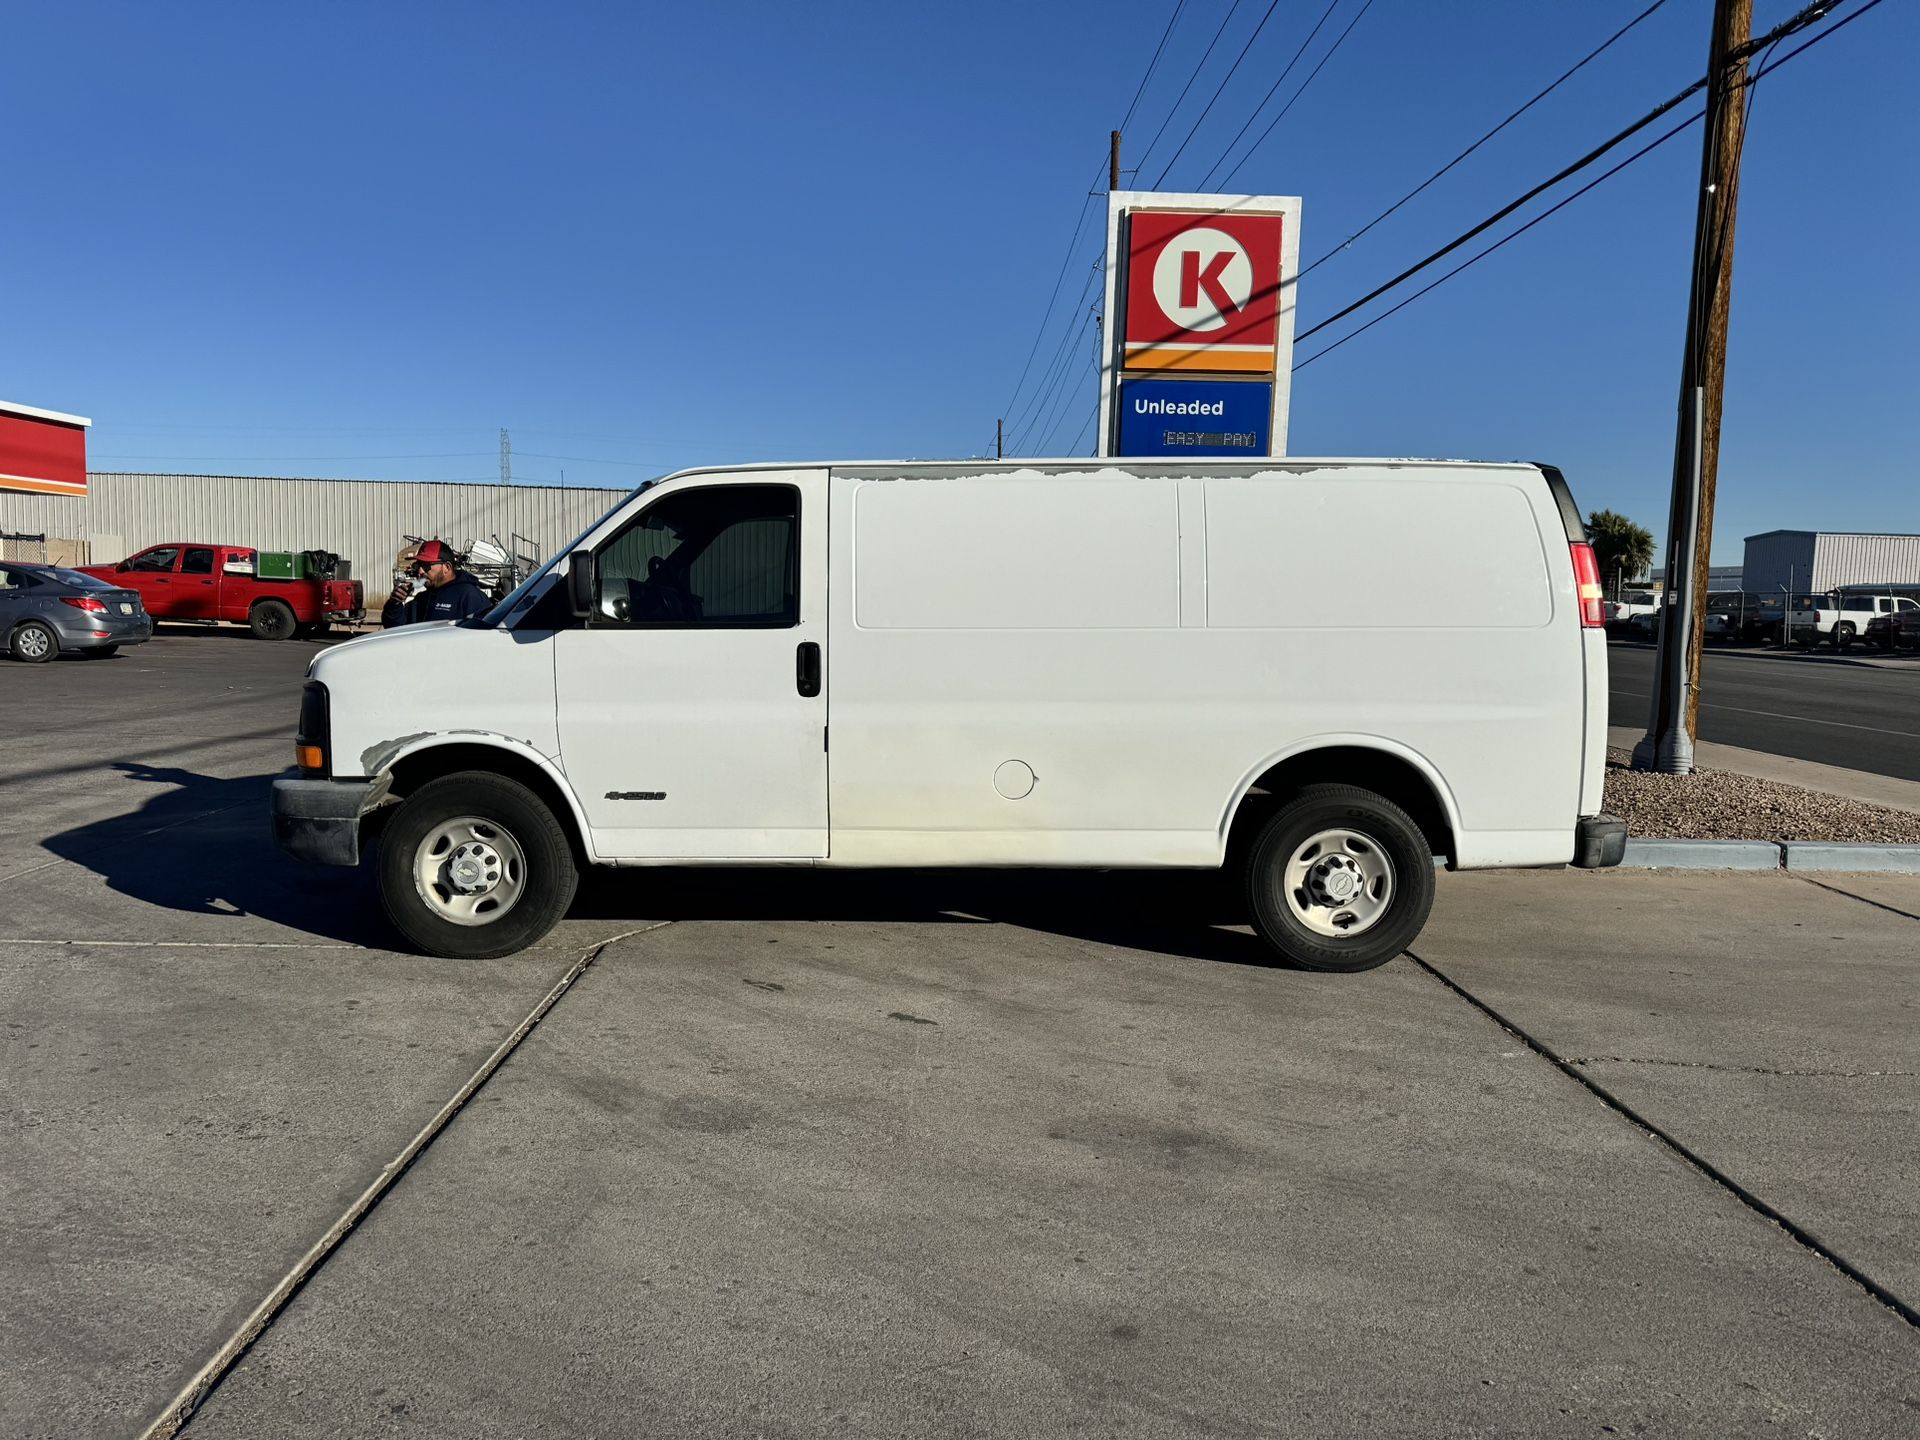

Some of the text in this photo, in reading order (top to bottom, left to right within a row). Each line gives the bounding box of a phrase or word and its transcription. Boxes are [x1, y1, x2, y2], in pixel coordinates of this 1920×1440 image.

[1179, 251, 1241, 325] K
[1135, 399, 1223, 416] Unleaded
[1166, 431, 1251, 447] EASY PAY
